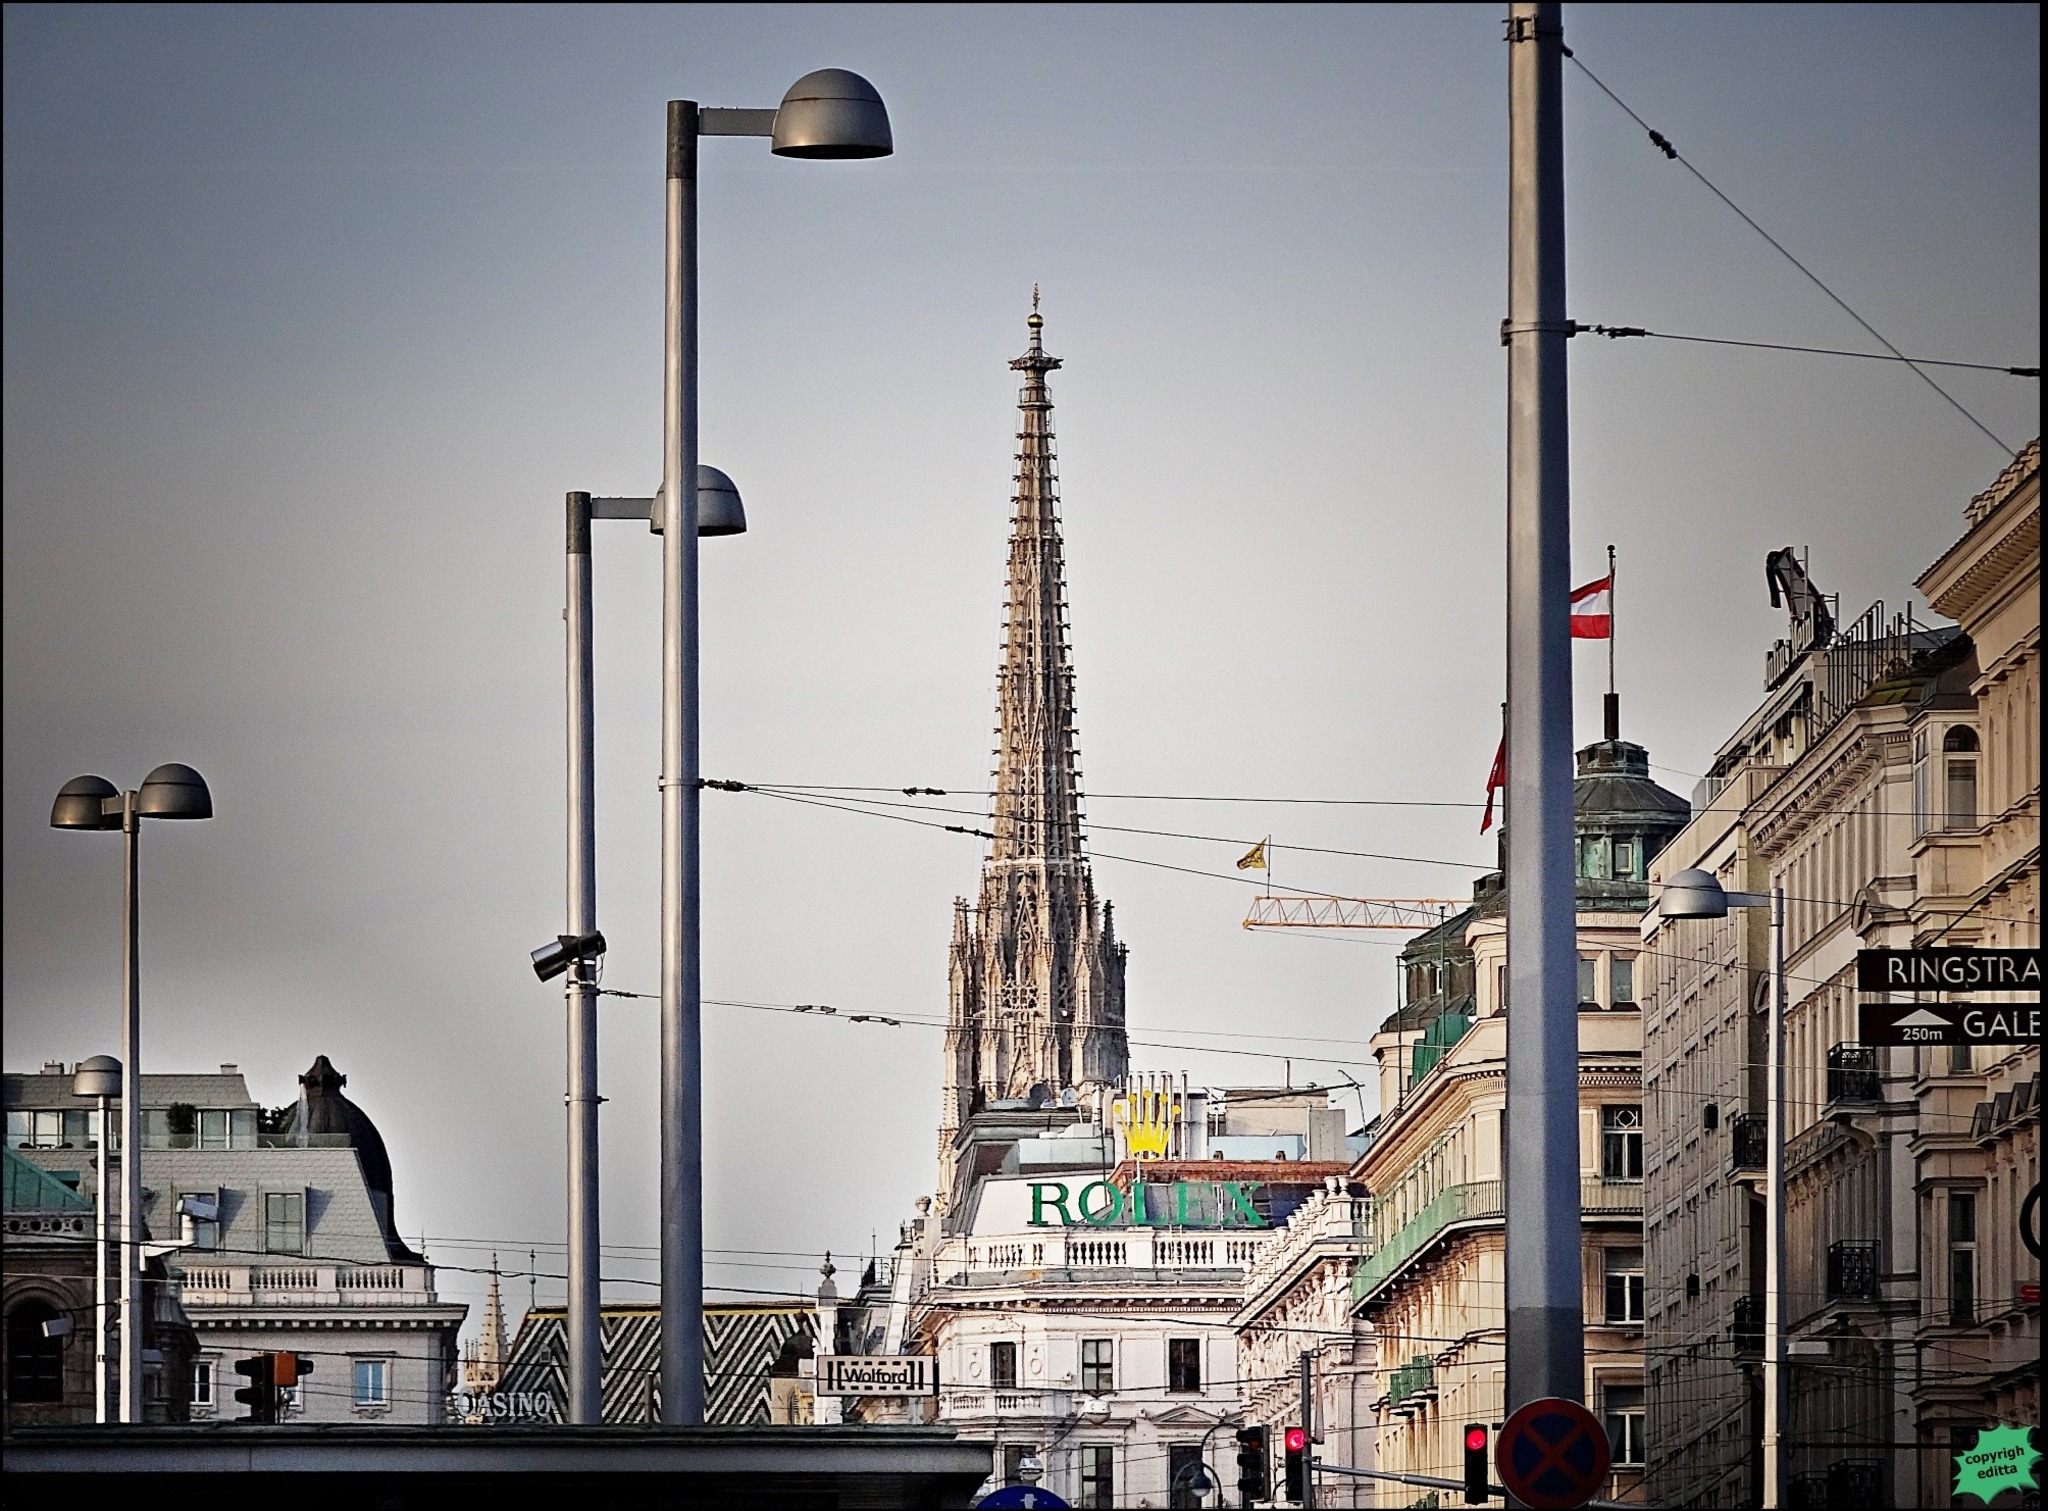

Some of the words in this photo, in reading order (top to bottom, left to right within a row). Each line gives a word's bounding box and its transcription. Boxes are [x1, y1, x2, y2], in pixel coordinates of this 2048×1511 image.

[1888, 956, 2040, 984] RINGSTRA
[1902, 1027, 1943, 1041] 250m
[1963, 1010, 2040, 1038] GALE
[1027, 1180, 1268, 1226] ROLEX
[844, 1367, 908, 1384] Wolford
[457, 1391, 551, 1417] CASINO
